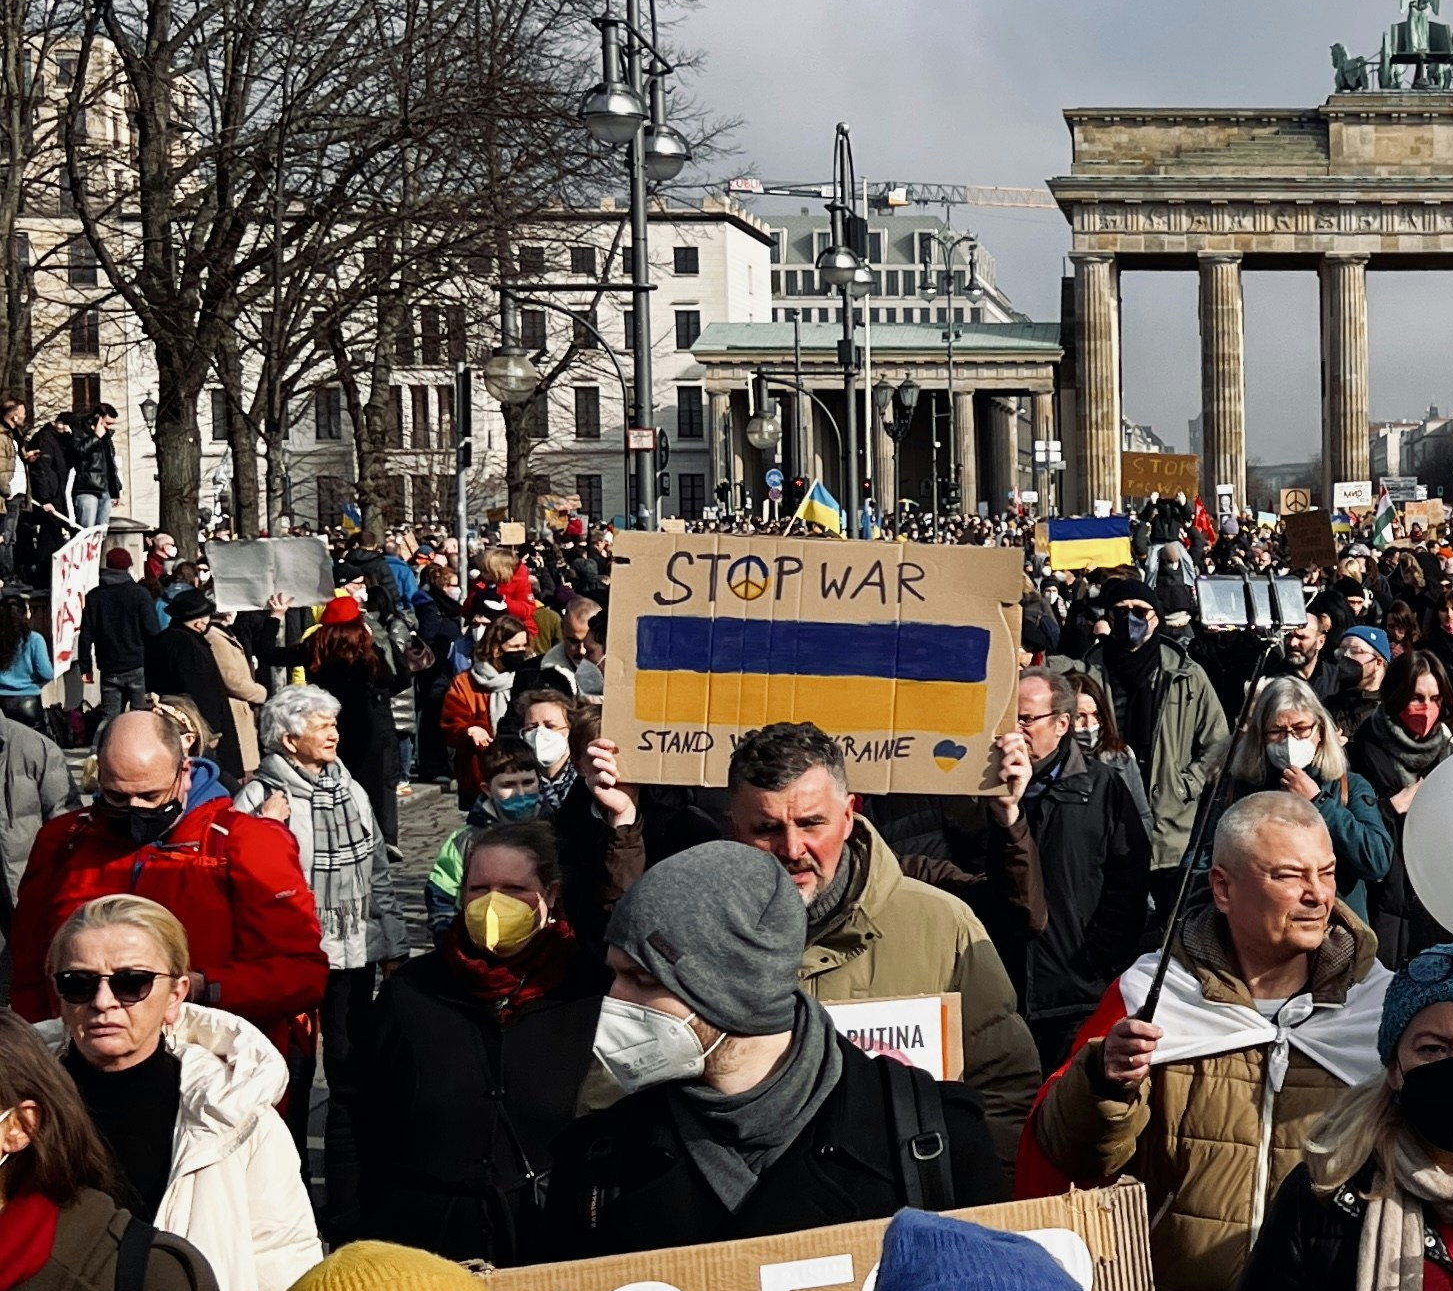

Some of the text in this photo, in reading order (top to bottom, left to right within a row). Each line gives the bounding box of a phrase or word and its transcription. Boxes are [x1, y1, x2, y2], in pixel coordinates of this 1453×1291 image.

[653, 551, 926, 606] STOP WAR
[637, 730, 715, 755] STAND
[831, 735, 916, 764] RAINE
[847, 1024, 925, 1052] PUTINA
